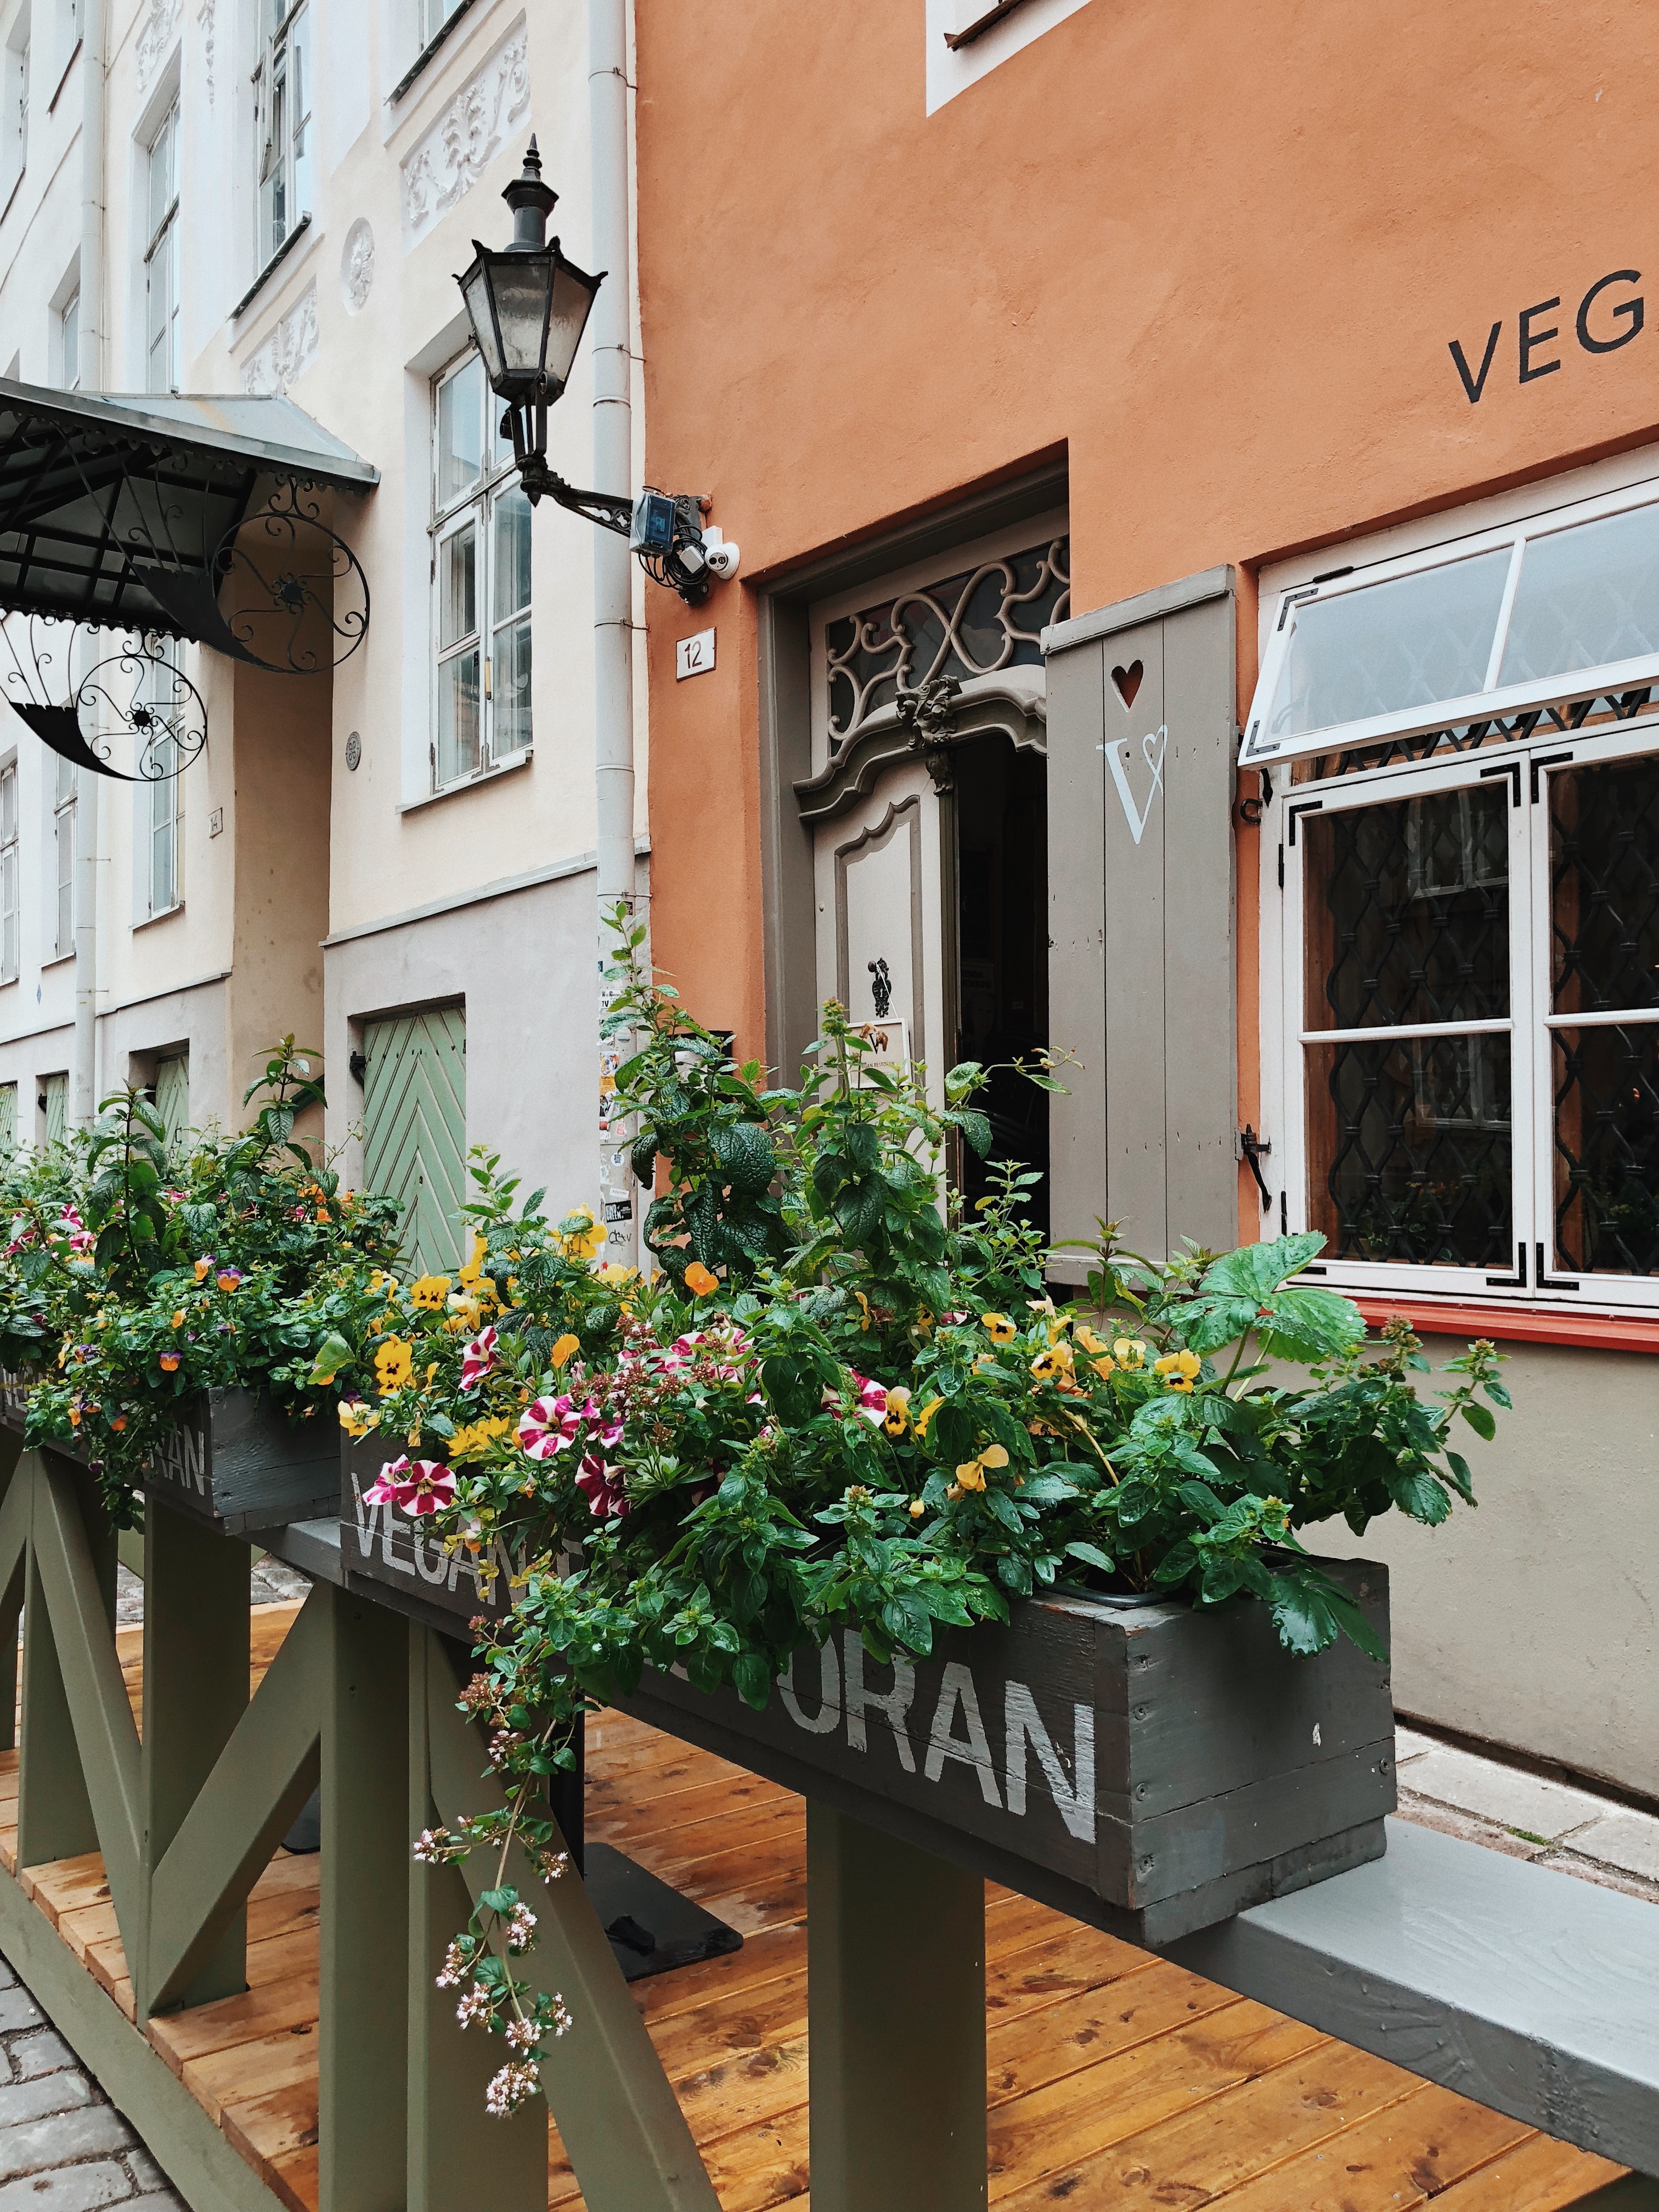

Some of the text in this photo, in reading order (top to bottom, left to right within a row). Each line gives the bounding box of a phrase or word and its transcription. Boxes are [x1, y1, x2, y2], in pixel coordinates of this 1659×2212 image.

[1448, 270, 1644, 404] VEG
[685, 641, 702, 668] 12
[210, 815, 218, 831] 14
